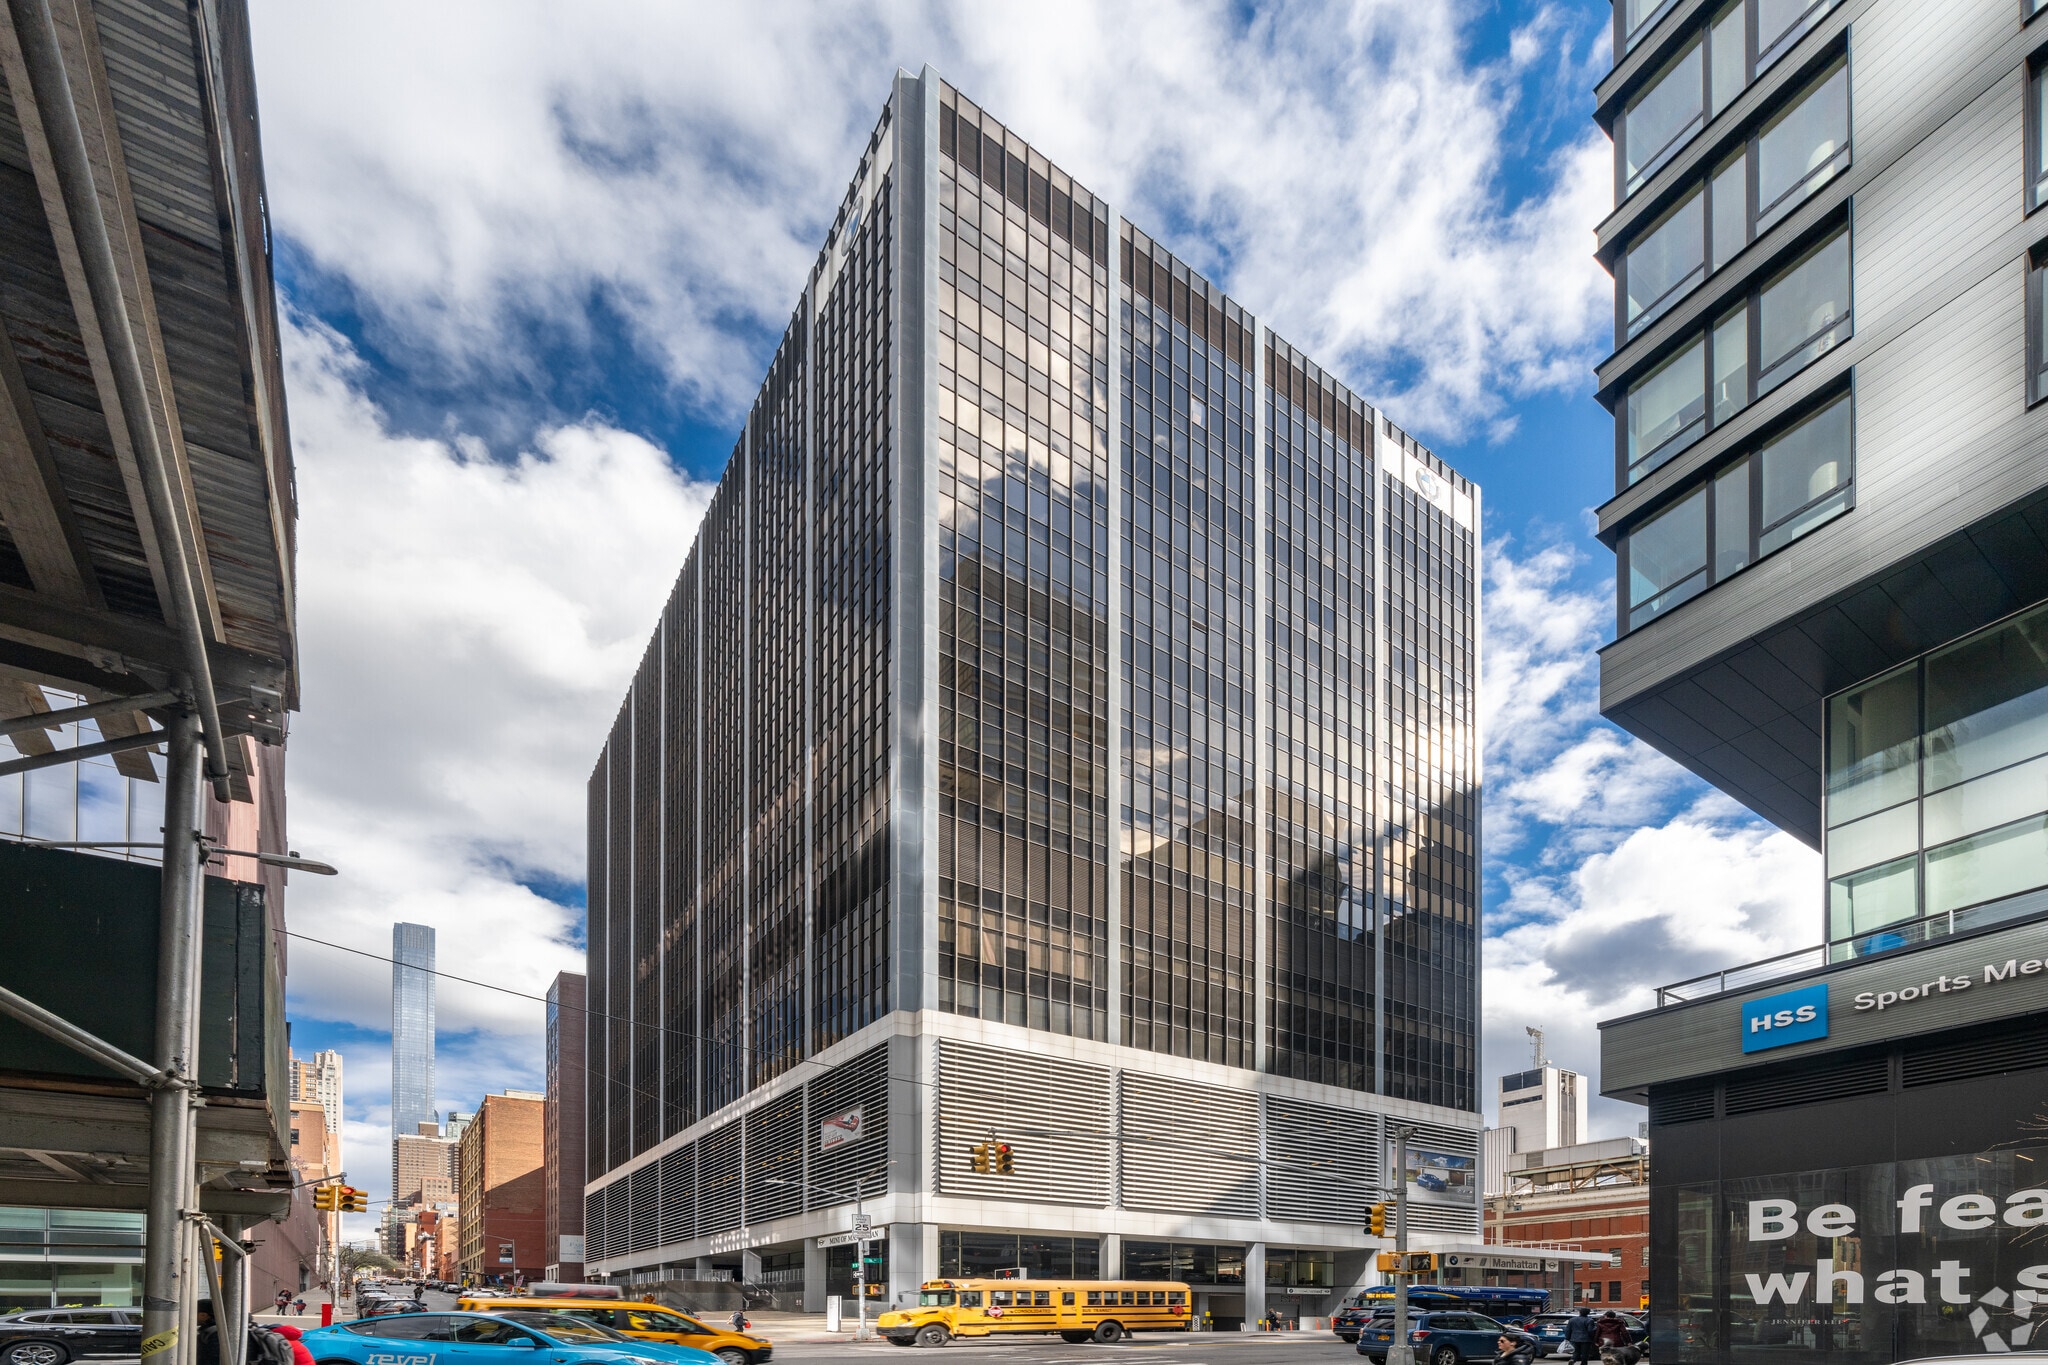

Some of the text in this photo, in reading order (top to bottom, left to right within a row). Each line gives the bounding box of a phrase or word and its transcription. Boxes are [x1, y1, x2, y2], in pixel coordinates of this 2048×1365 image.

[1854, 958, 2048, 1010] Sports Me
[1751, 1005, 1817, 1033] HSS
[1748, 1183, 2048, 1242] Be fea
[855, 1223, 869, 1231] 25
[1493, 1258, 1538, 1269] Manhattan
[1744, 1258, 1971, 1305] what
[366, 1353, 437, 1365] revel
